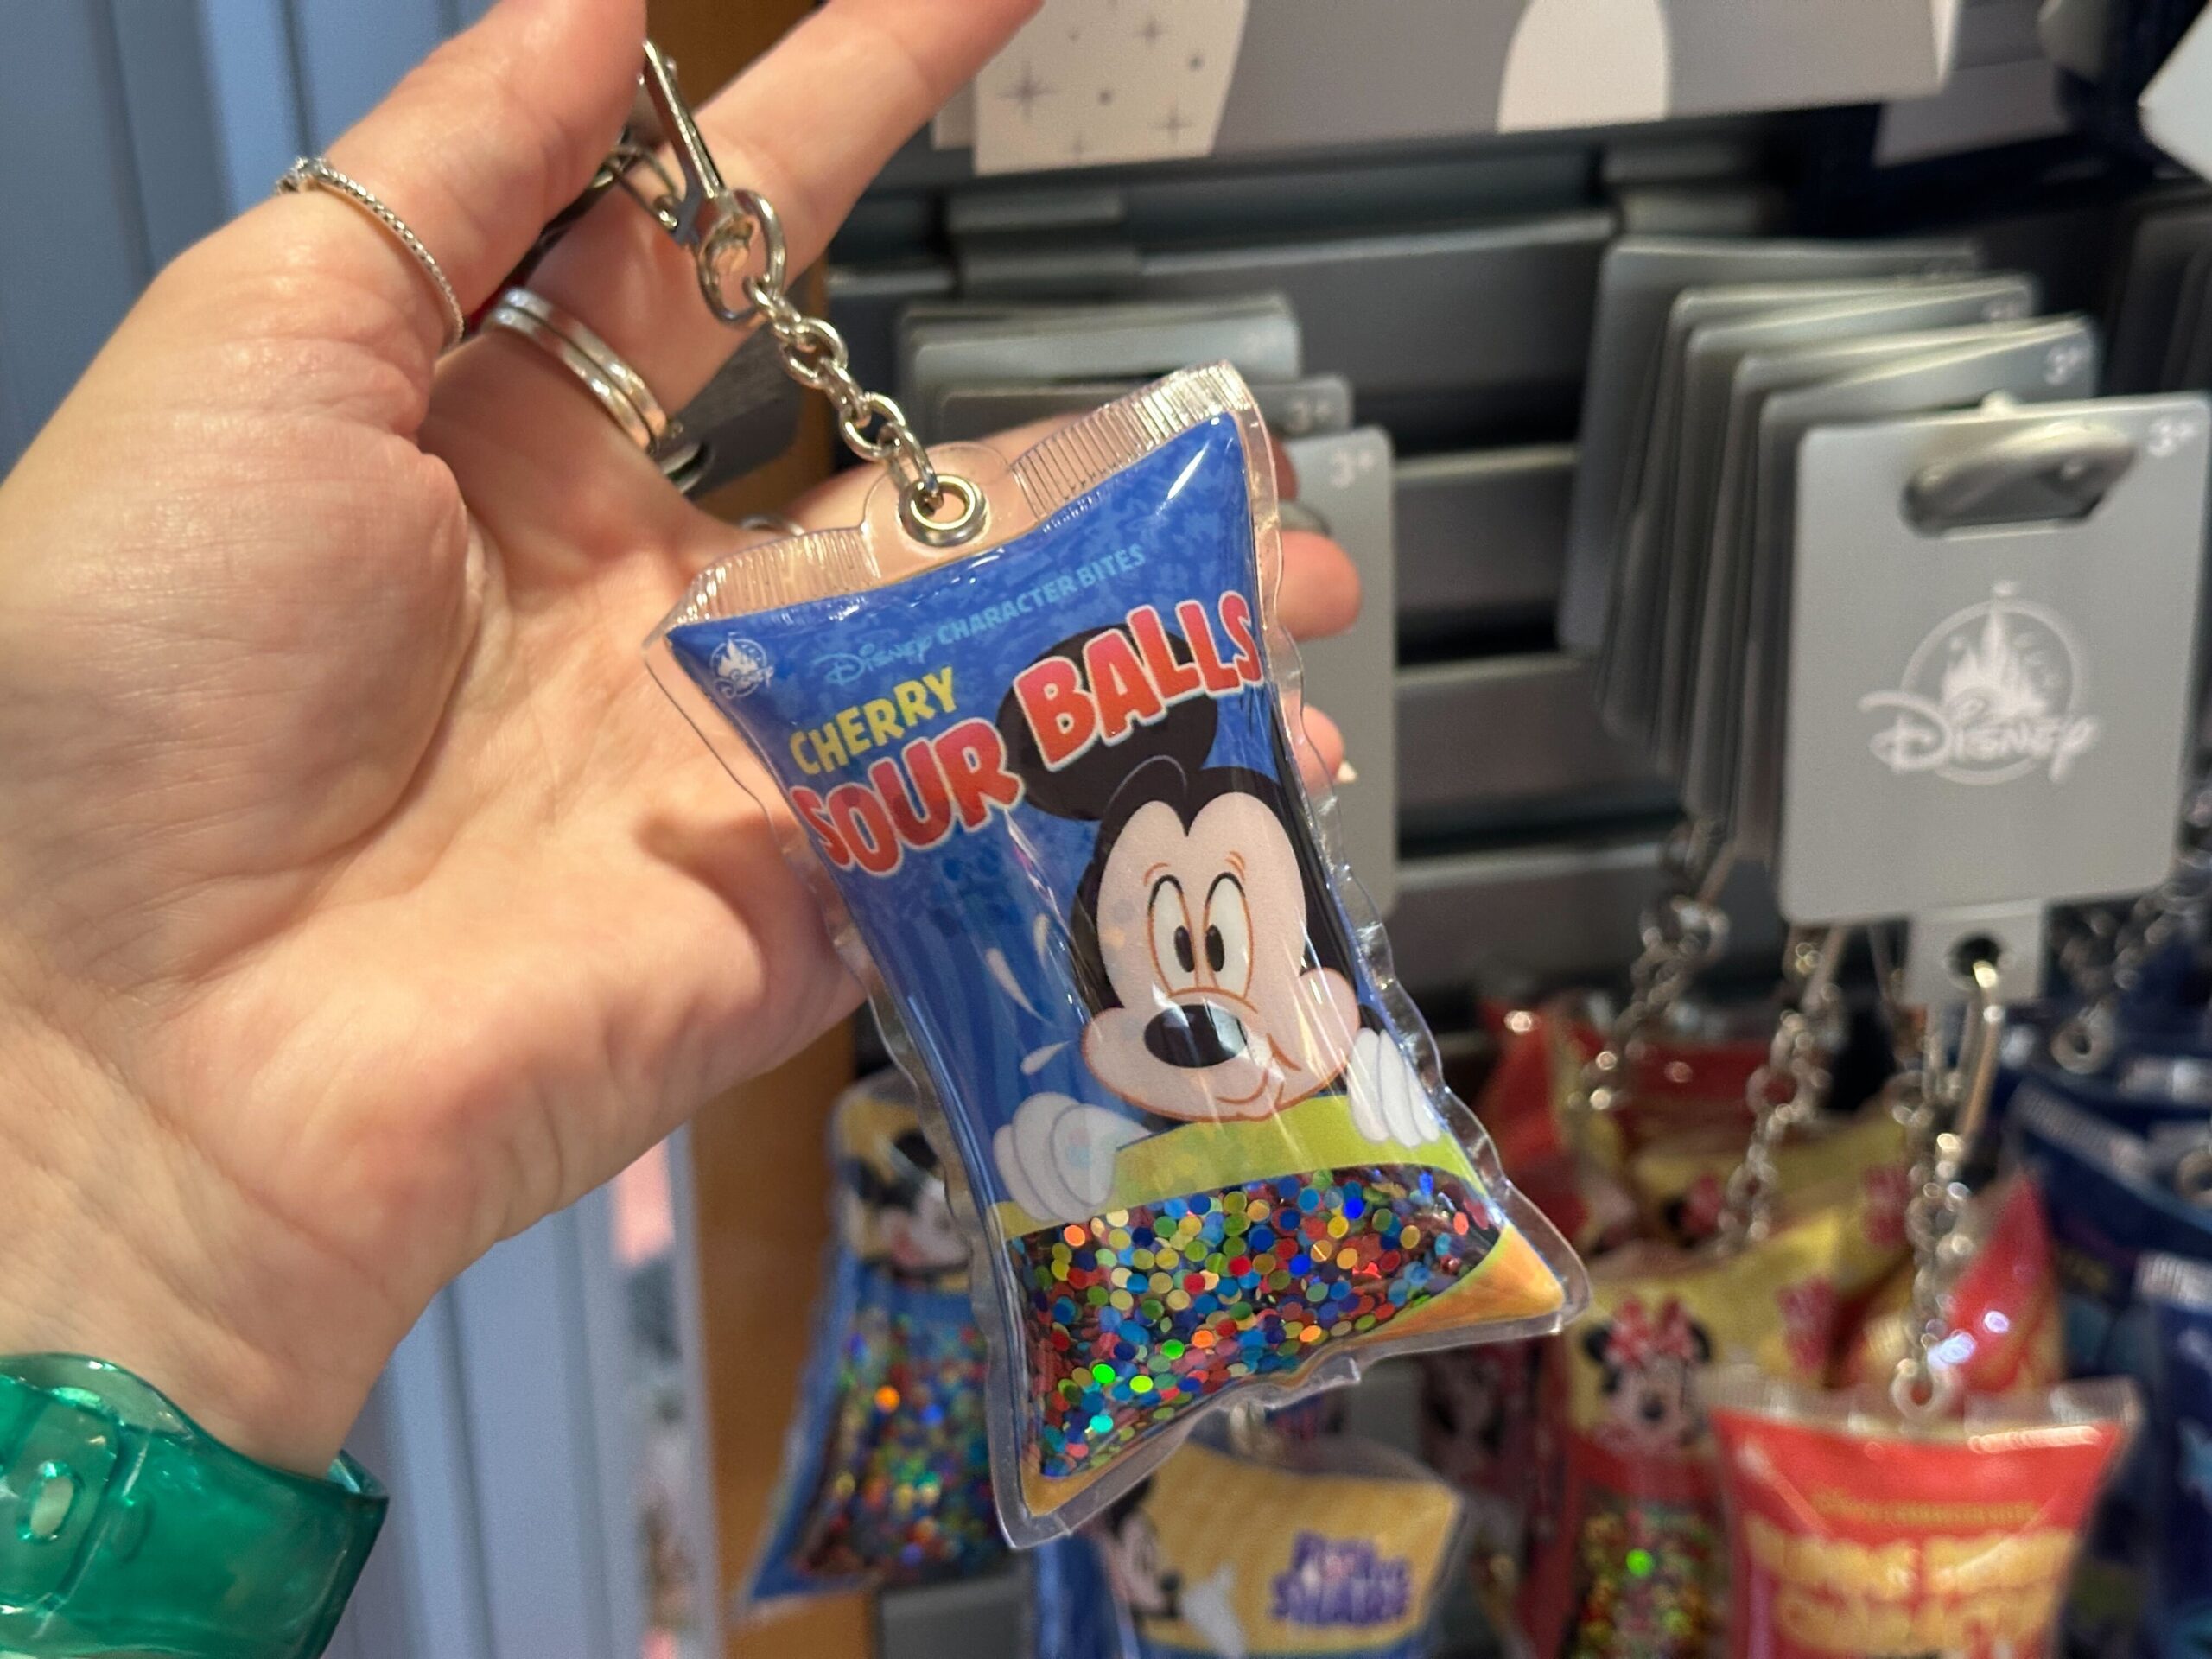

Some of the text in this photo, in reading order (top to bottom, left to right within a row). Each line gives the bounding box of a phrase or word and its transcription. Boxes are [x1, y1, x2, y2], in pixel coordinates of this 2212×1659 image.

[938, 574, 1079, 645] CHARACTER
[1077, 543, 1147, 588] BITES
[788, 589, 1264, 878] SOUR BALLS
[790, 666, 957, 775] CHERRY
